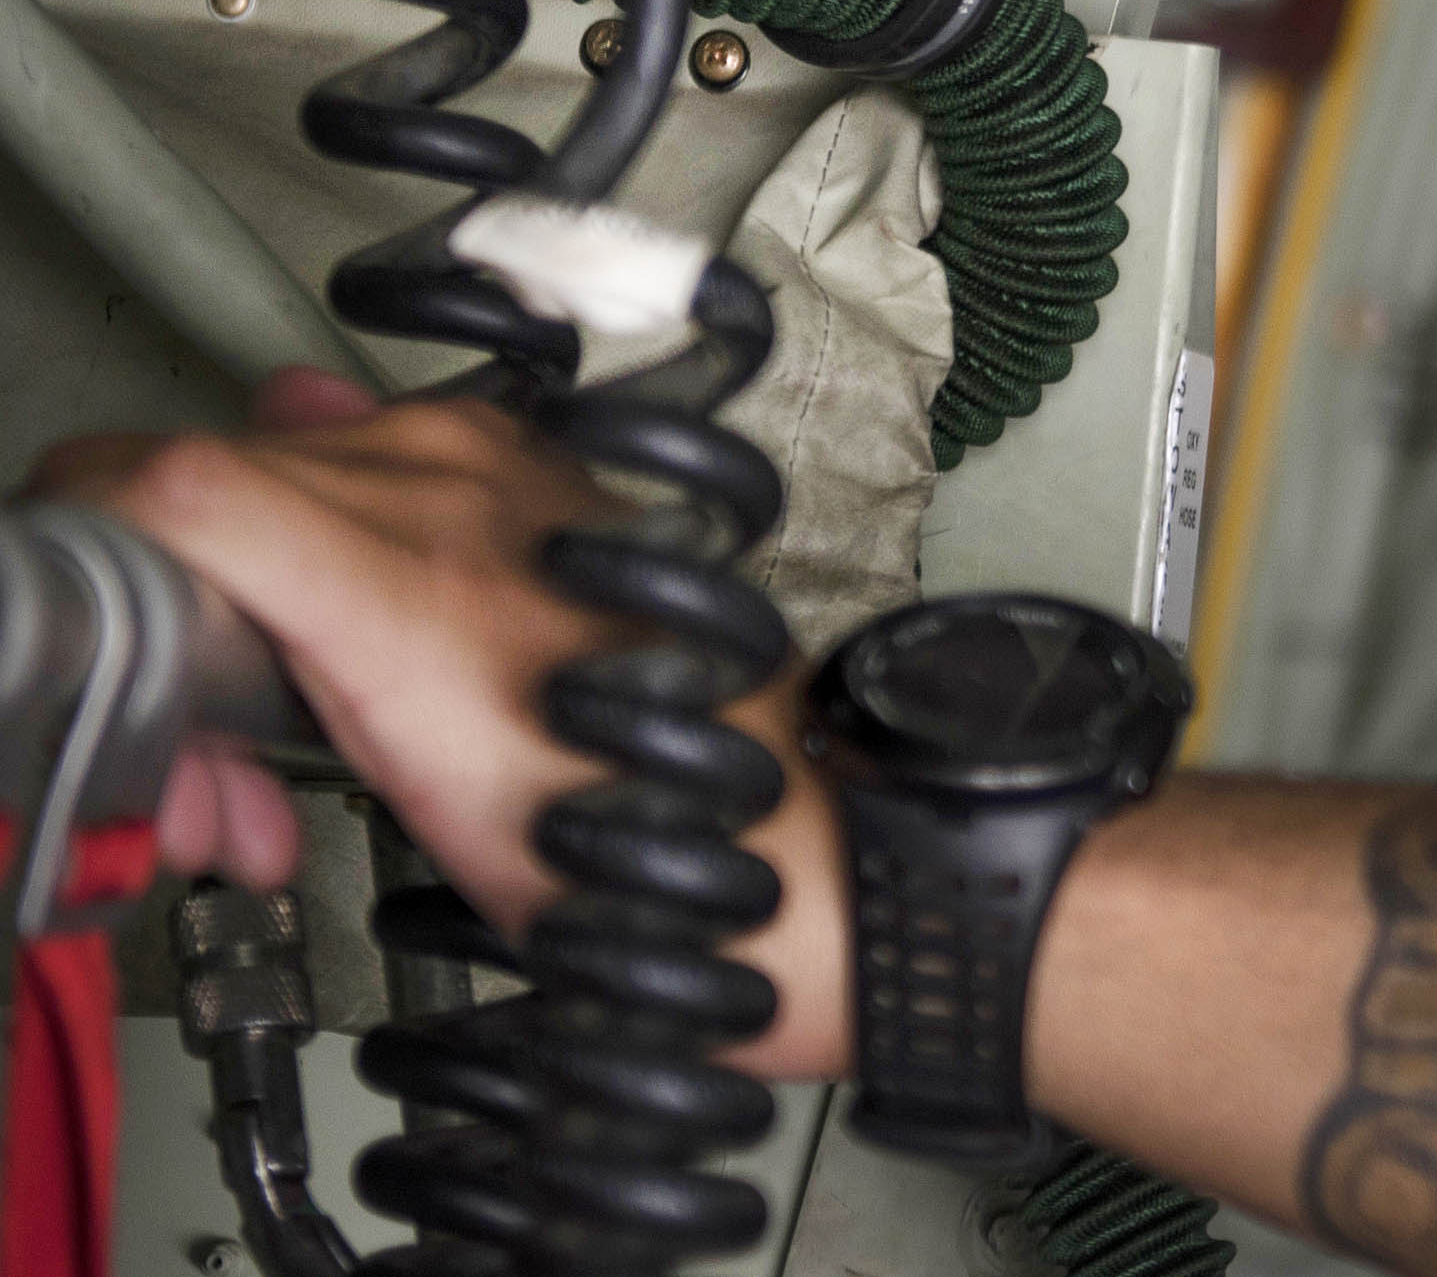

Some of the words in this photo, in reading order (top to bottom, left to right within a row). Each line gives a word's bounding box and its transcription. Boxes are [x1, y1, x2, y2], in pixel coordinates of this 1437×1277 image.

[1186, 430, 1200, 450] OXY
[1182, 468, 1197, 490] REG
[1179, 507, 1197, 529] HOSE
